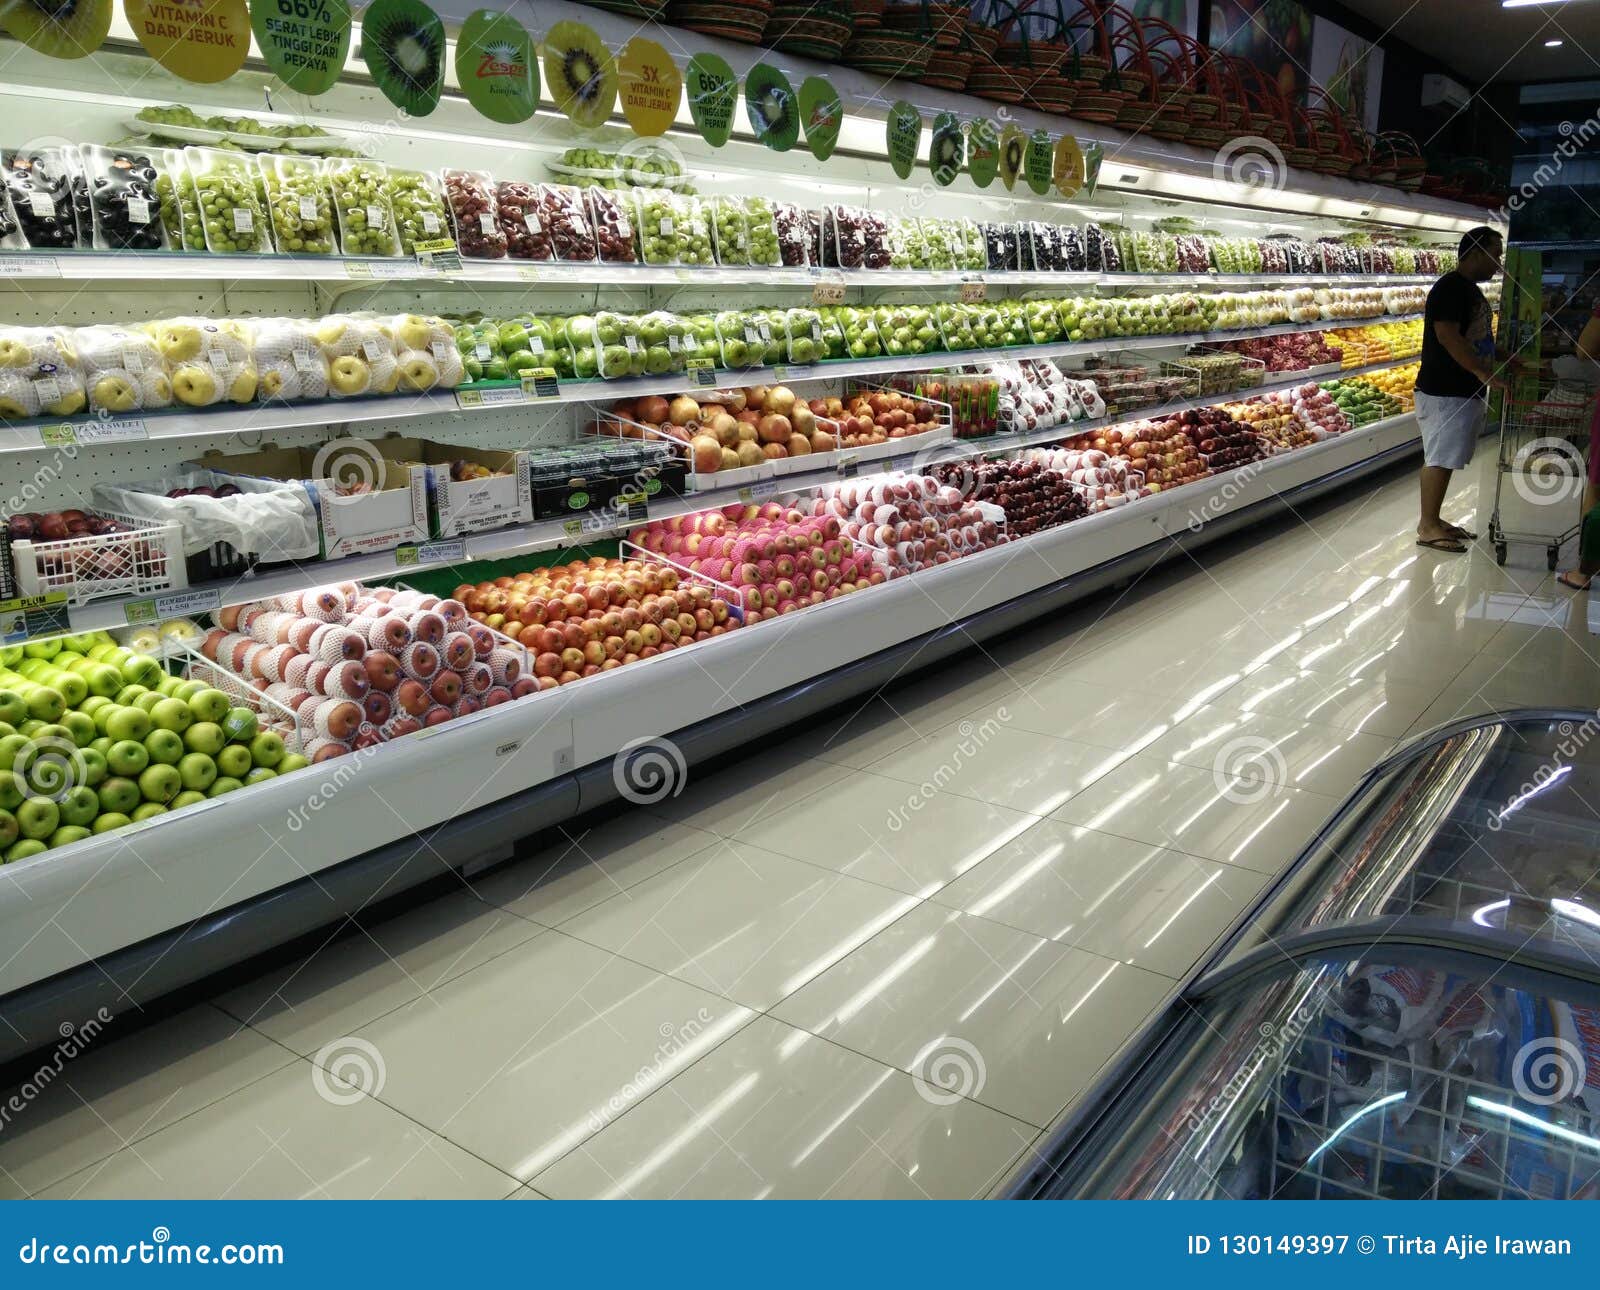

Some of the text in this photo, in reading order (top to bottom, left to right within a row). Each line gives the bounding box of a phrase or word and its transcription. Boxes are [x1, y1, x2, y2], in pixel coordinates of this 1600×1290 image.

[148, 4, 215, 27] VITAMIN
[219, 16, 228, 30] C
[278, 0, 332, 24] 66%
[145, 21, 236, 48] DARI JERUK
[265, 18, 341, 45] SERAT LEBIH
[271, 34, 338, 60] TINGGI DARI
[284, 54, 328, 73] PEPAYA
[641, 64, 660, 84] 3X
[630, 82, 666, 98] VITAMIN
[627, 95, 673, 112] DARI JERUK
[20, 595, 47, 607] PLUM
